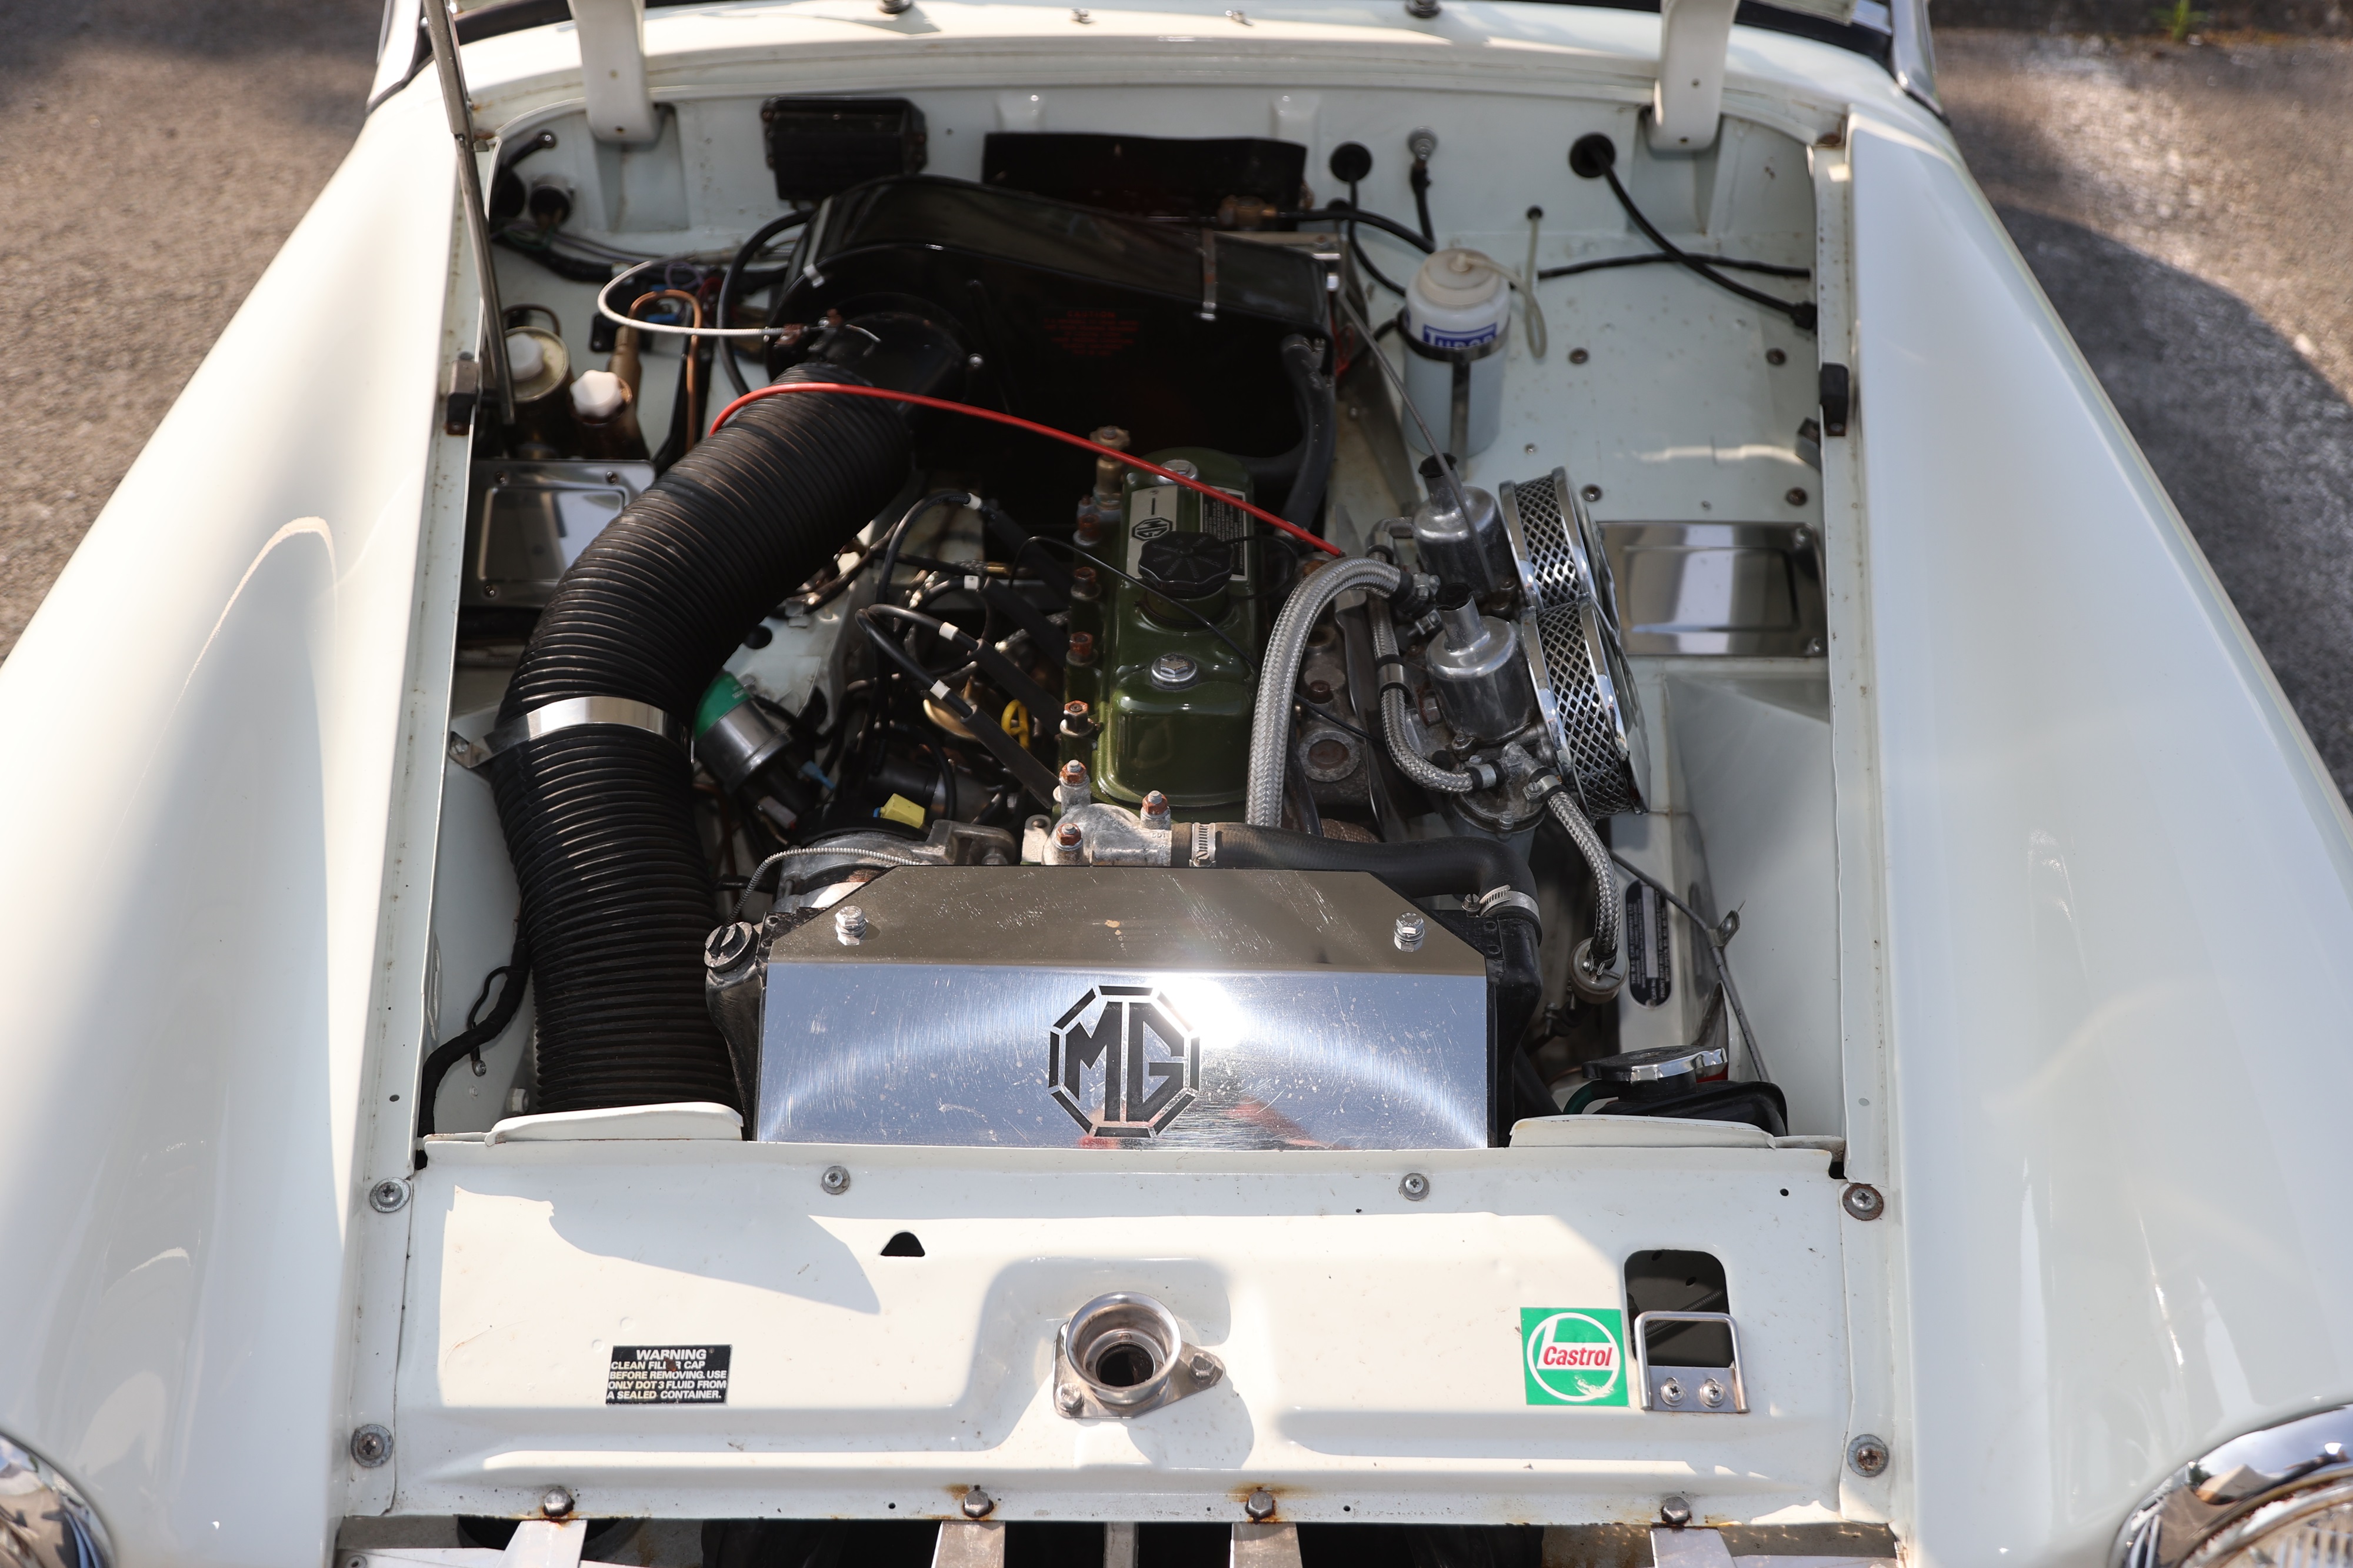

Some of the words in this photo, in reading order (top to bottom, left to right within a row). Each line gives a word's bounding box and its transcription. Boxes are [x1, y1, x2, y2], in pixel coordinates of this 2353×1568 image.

[1062, 1000, 1186, 1123] MG
[636, 1349, 706, 1360] WARNING
[1542, 1345, 1613, 1366] Castrol
[611, 1361, 645, 1369] CLEAN
[648, 1361, 681, 1369] FILLR
[684, 1361, 705, 1369] CAP
[609, 1371, 648, 1380] BEFORE
[649, 1370, 705, 1379] REMOVING.
[706, 1370, 727, 1379] USE
[608, 1381, 634, 1389] ONLY
[635, 1381, 657, 1389] DOT
[658, 1381, 664, 1389] 3
[666, 1380, 695, 1389] FLUID
[697, 1380, 726, 1389] FROM
[606, 1391, 614, 1399] A
[661, 1390, 721, 1399] CONTAINER.
